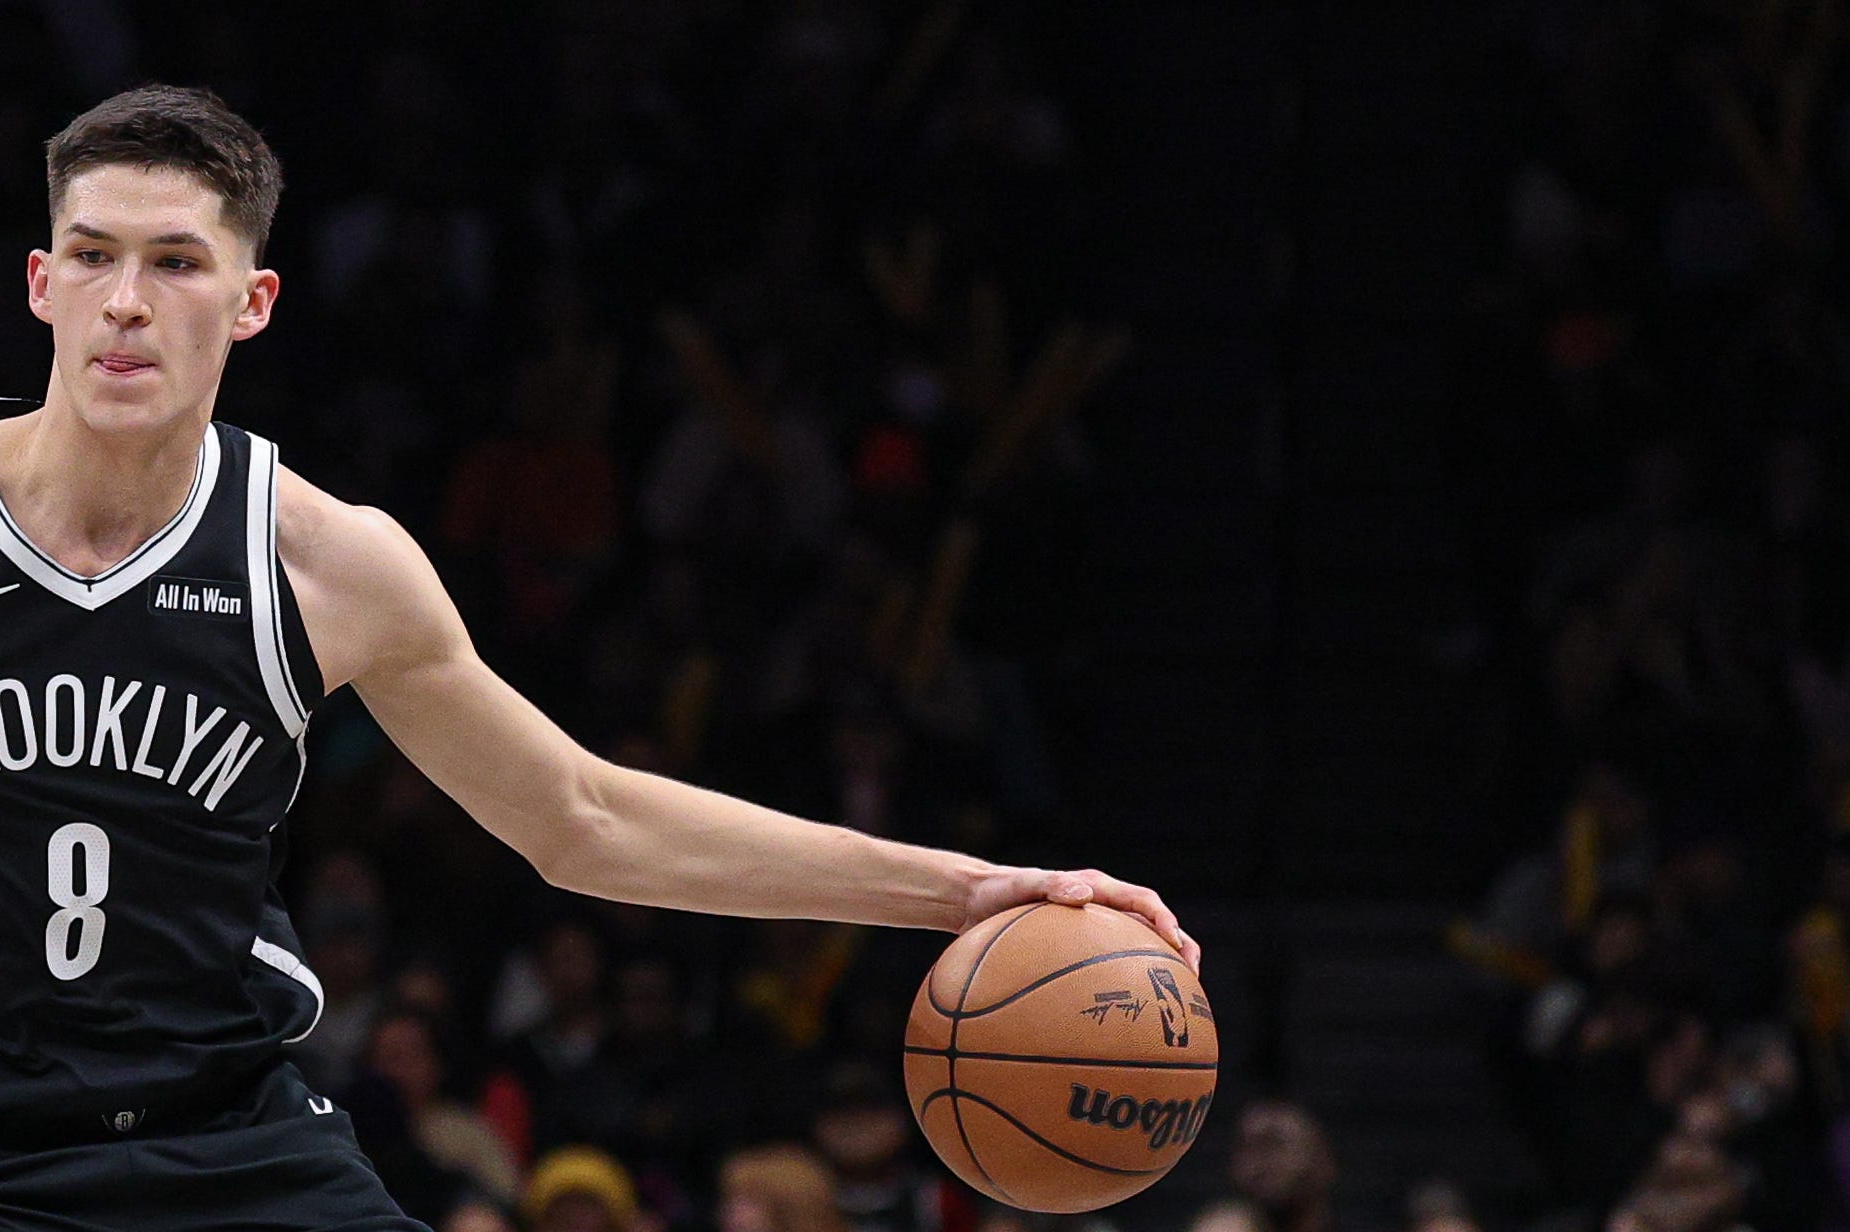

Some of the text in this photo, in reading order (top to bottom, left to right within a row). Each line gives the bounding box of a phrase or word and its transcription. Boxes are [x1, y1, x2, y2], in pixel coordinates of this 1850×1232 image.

[155, 583, 241, 614] All In Won
[45, 822, 110, 982] 8
